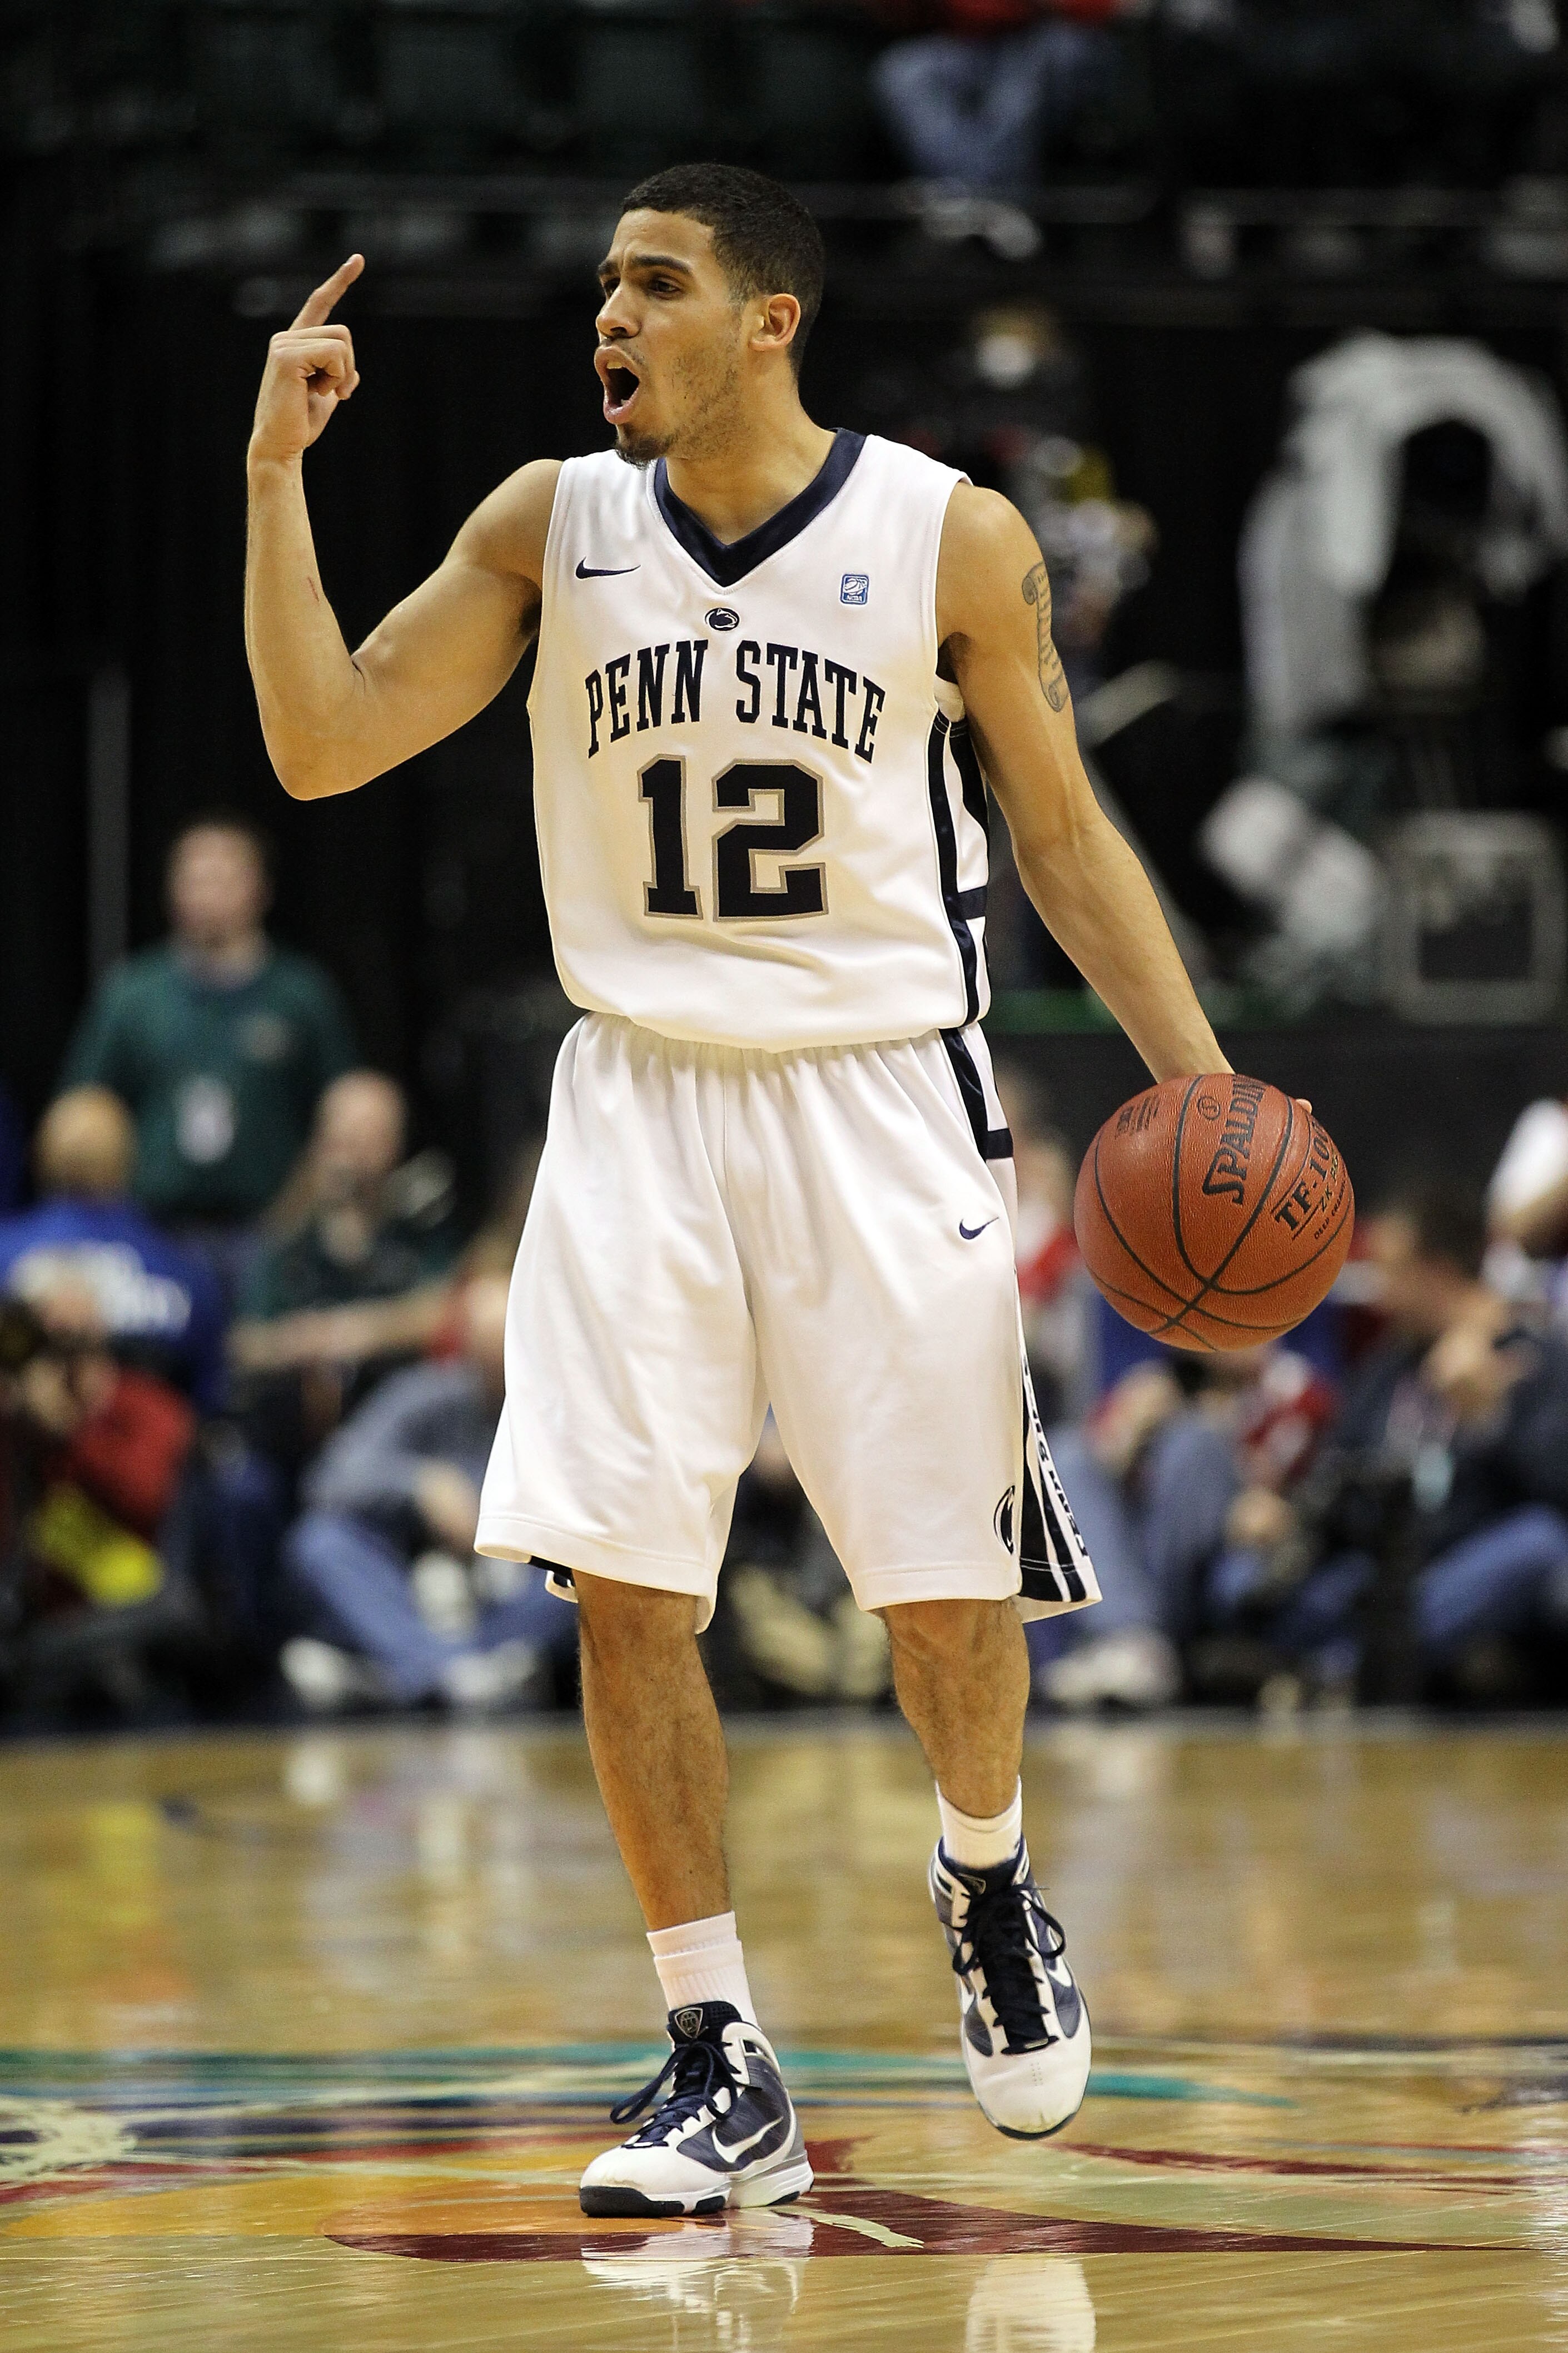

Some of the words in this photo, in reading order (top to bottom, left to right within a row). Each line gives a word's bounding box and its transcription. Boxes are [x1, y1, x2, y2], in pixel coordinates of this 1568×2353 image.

[585, 639, 709, 758] PENN
[735, 640, 886, 764] STATE
[637, 753, 828, 922] 12
